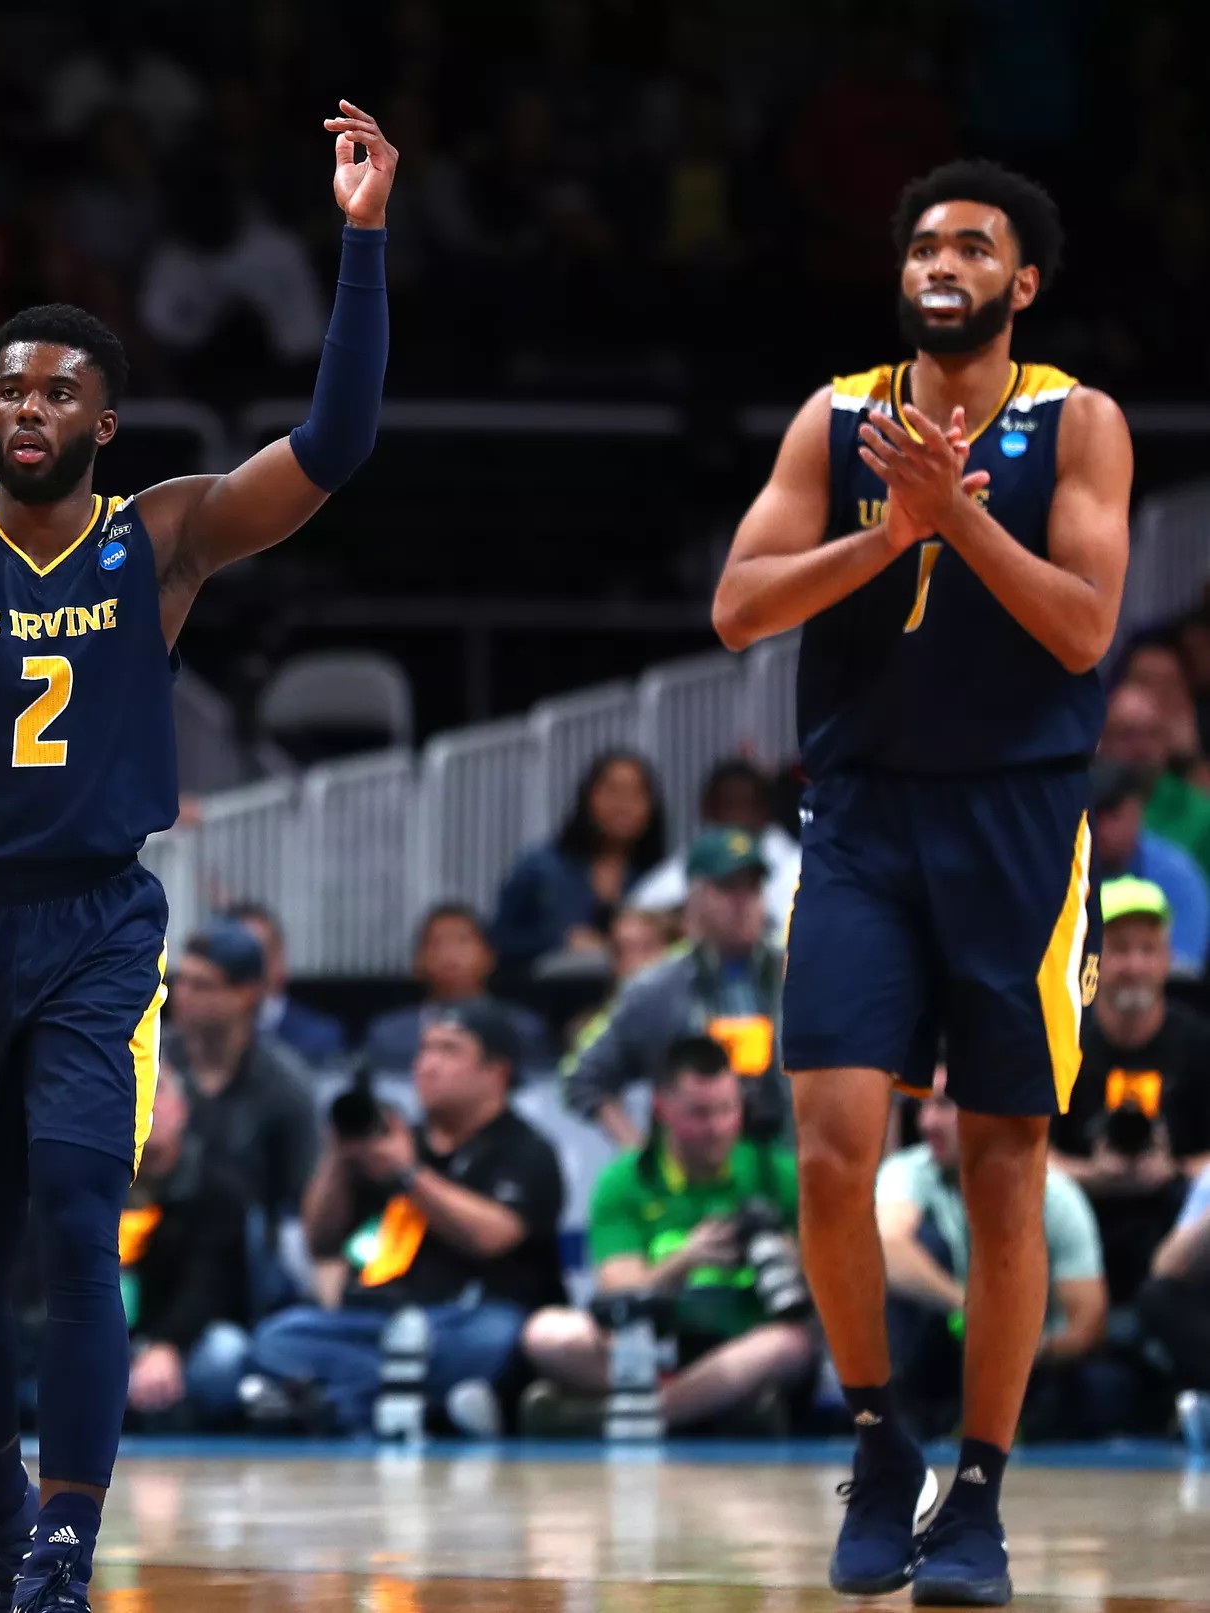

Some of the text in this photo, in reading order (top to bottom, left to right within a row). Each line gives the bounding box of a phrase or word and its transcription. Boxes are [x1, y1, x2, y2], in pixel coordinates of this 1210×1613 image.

[103, 549, 125, 567] NCAA
[9, 598, 119, 641] IRVINE
[12, 655, 74, 768] 2
